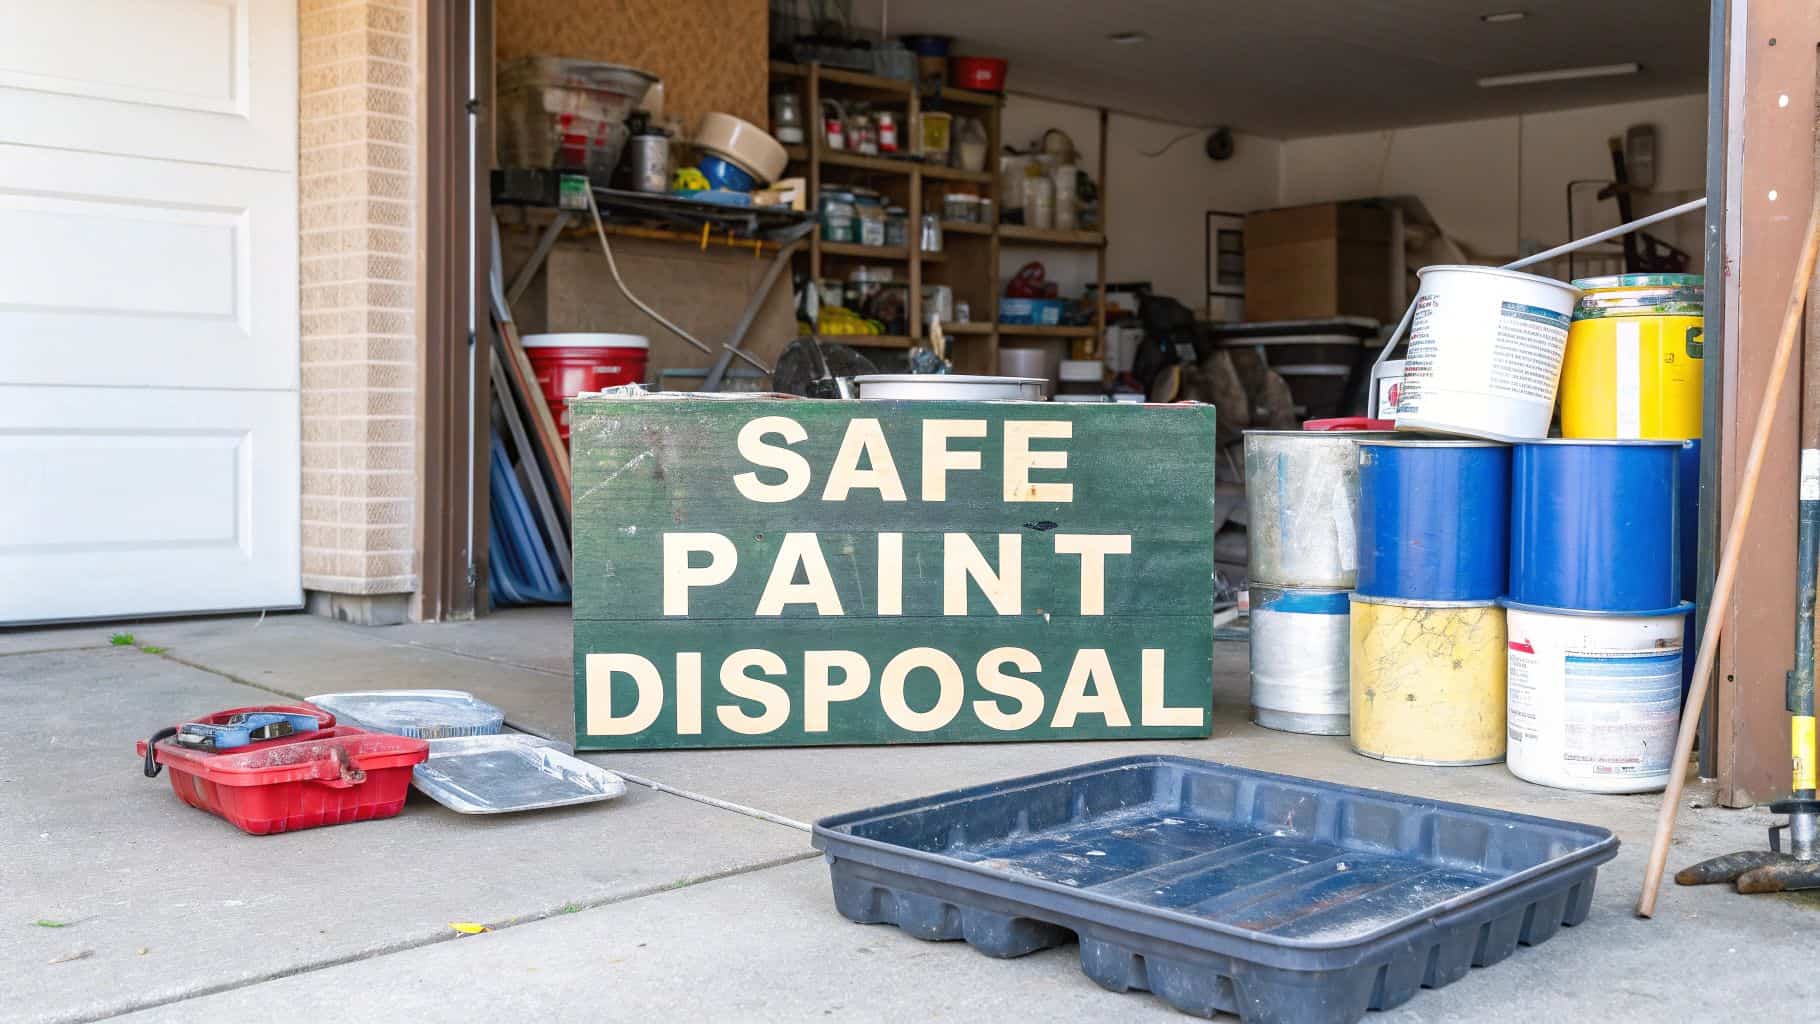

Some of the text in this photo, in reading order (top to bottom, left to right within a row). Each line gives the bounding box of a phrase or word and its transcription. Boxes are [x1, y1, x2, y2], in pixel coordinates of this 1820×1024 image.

[732, 415, 1074, 503] SAFE
[662, 532, 1132, 616] PAINT
[585, 646, 1205, 736] DISPOSAL
